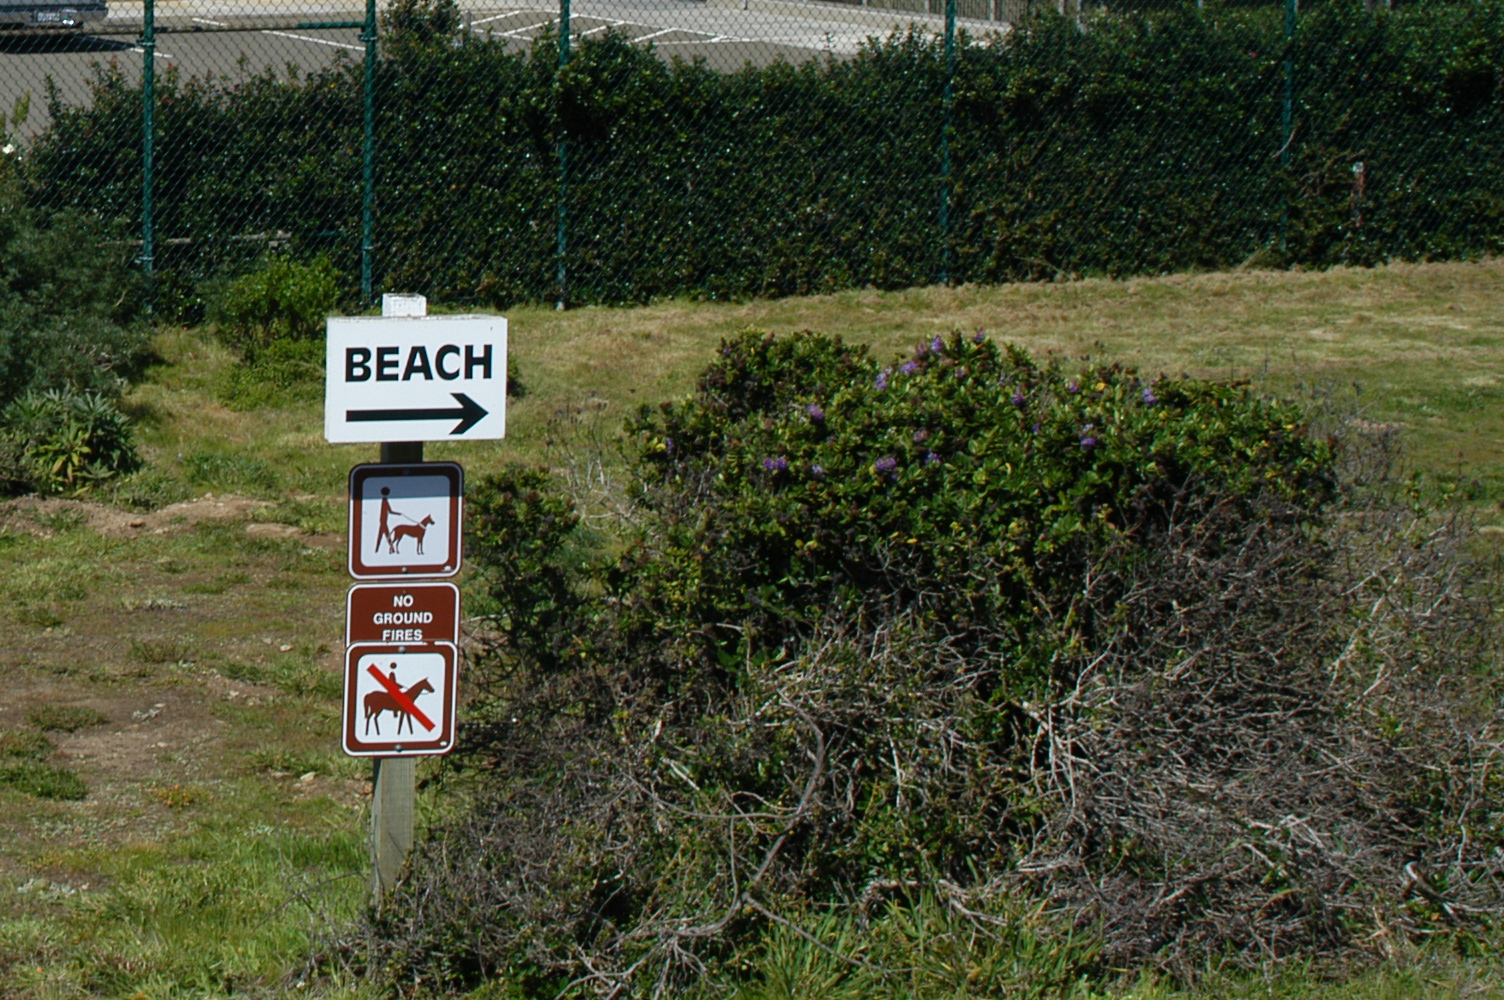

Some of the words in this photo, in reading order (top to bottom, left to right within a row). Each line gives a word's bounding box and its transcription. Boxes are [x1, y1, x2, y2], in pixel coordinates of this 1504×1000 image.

[345, 344, 492, 382] BEACH
[393, 594, 414, 607] NO
[373, 611, 433, 625] GROUND
[382, 629, 423, 641] FIRES
